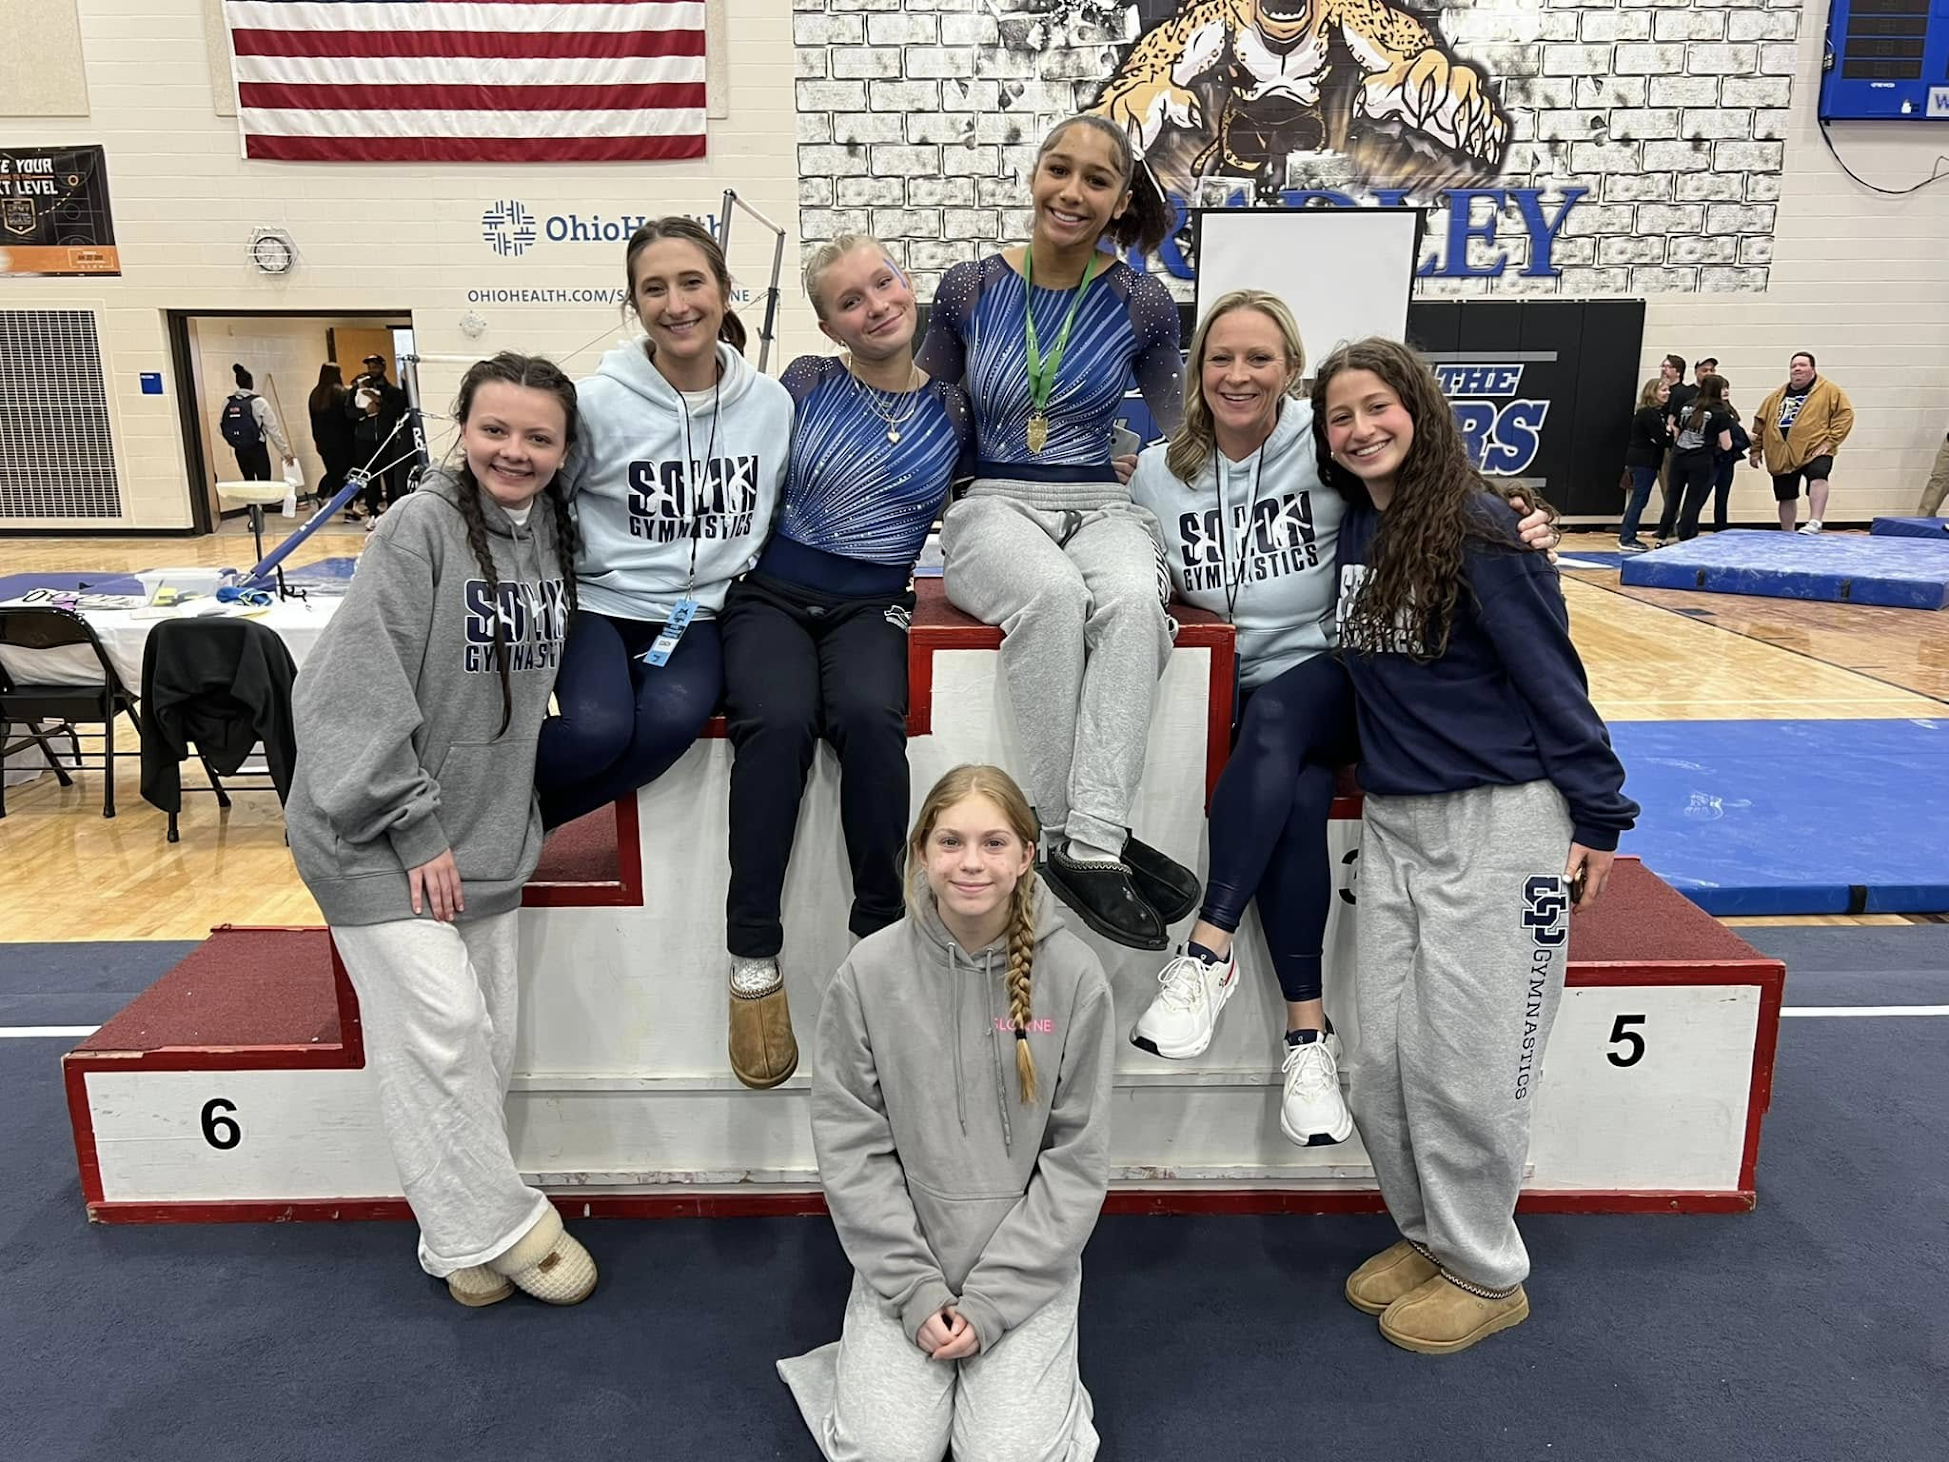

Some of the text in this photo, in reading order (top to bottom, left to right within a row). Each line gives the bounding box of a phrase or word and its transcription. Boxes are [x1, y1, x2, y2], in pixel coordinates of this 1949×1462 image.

[0, 158, 54, 174] E YOUR
[16, 180, 59, 195] LEVEL
[546, 213, 722, 242] OhioHh
[1435, 363, 1525, 397] THE
[1183, 544, 1319, 592] GYMSTICS
[1515, 949, 1552, 1100] GYMNASTICS
[1606, 1014, 1646, 1067] 5
[200, 1098, 241, 1150] 6
